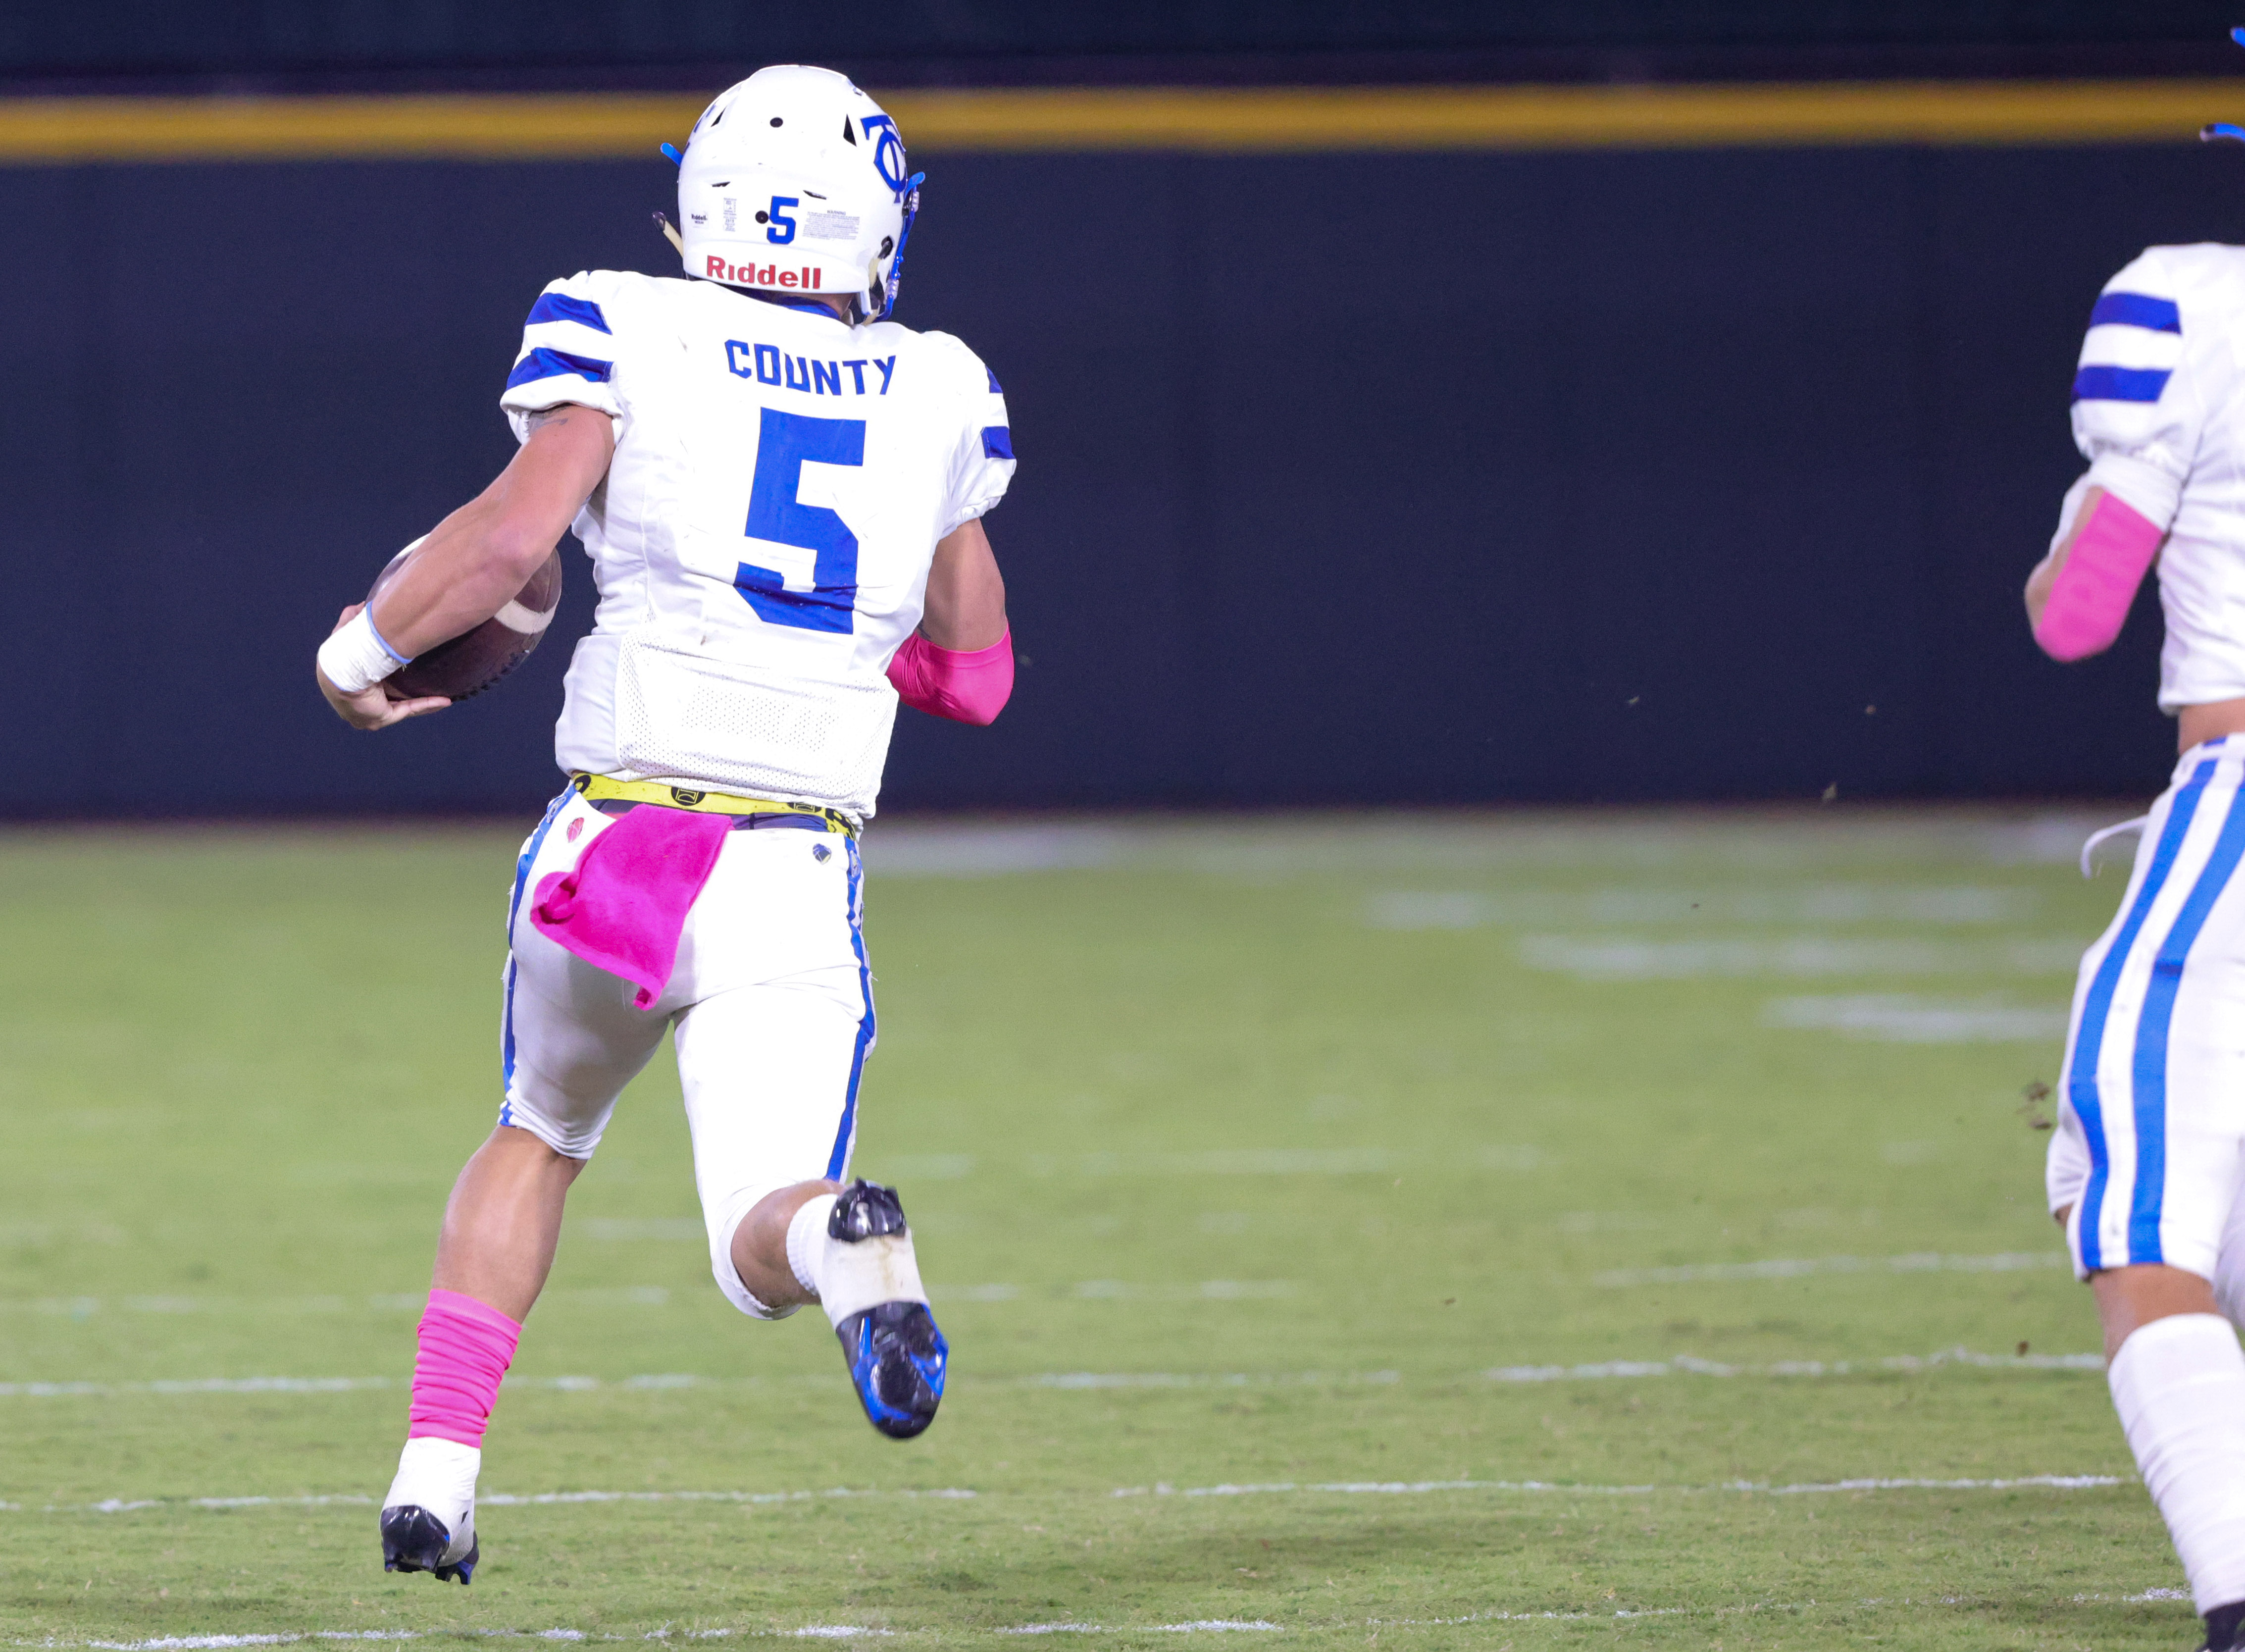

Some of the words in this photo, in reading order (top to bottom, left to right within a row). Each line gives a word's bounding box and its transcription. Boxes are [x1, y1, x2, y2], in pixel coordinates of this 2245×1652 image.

[766, 196, 799, 245] 5
[707, 255, 821, 290] Riddell
[724, 339, 896, 396] COUNTY
[733, 406, 867, 635] 5
